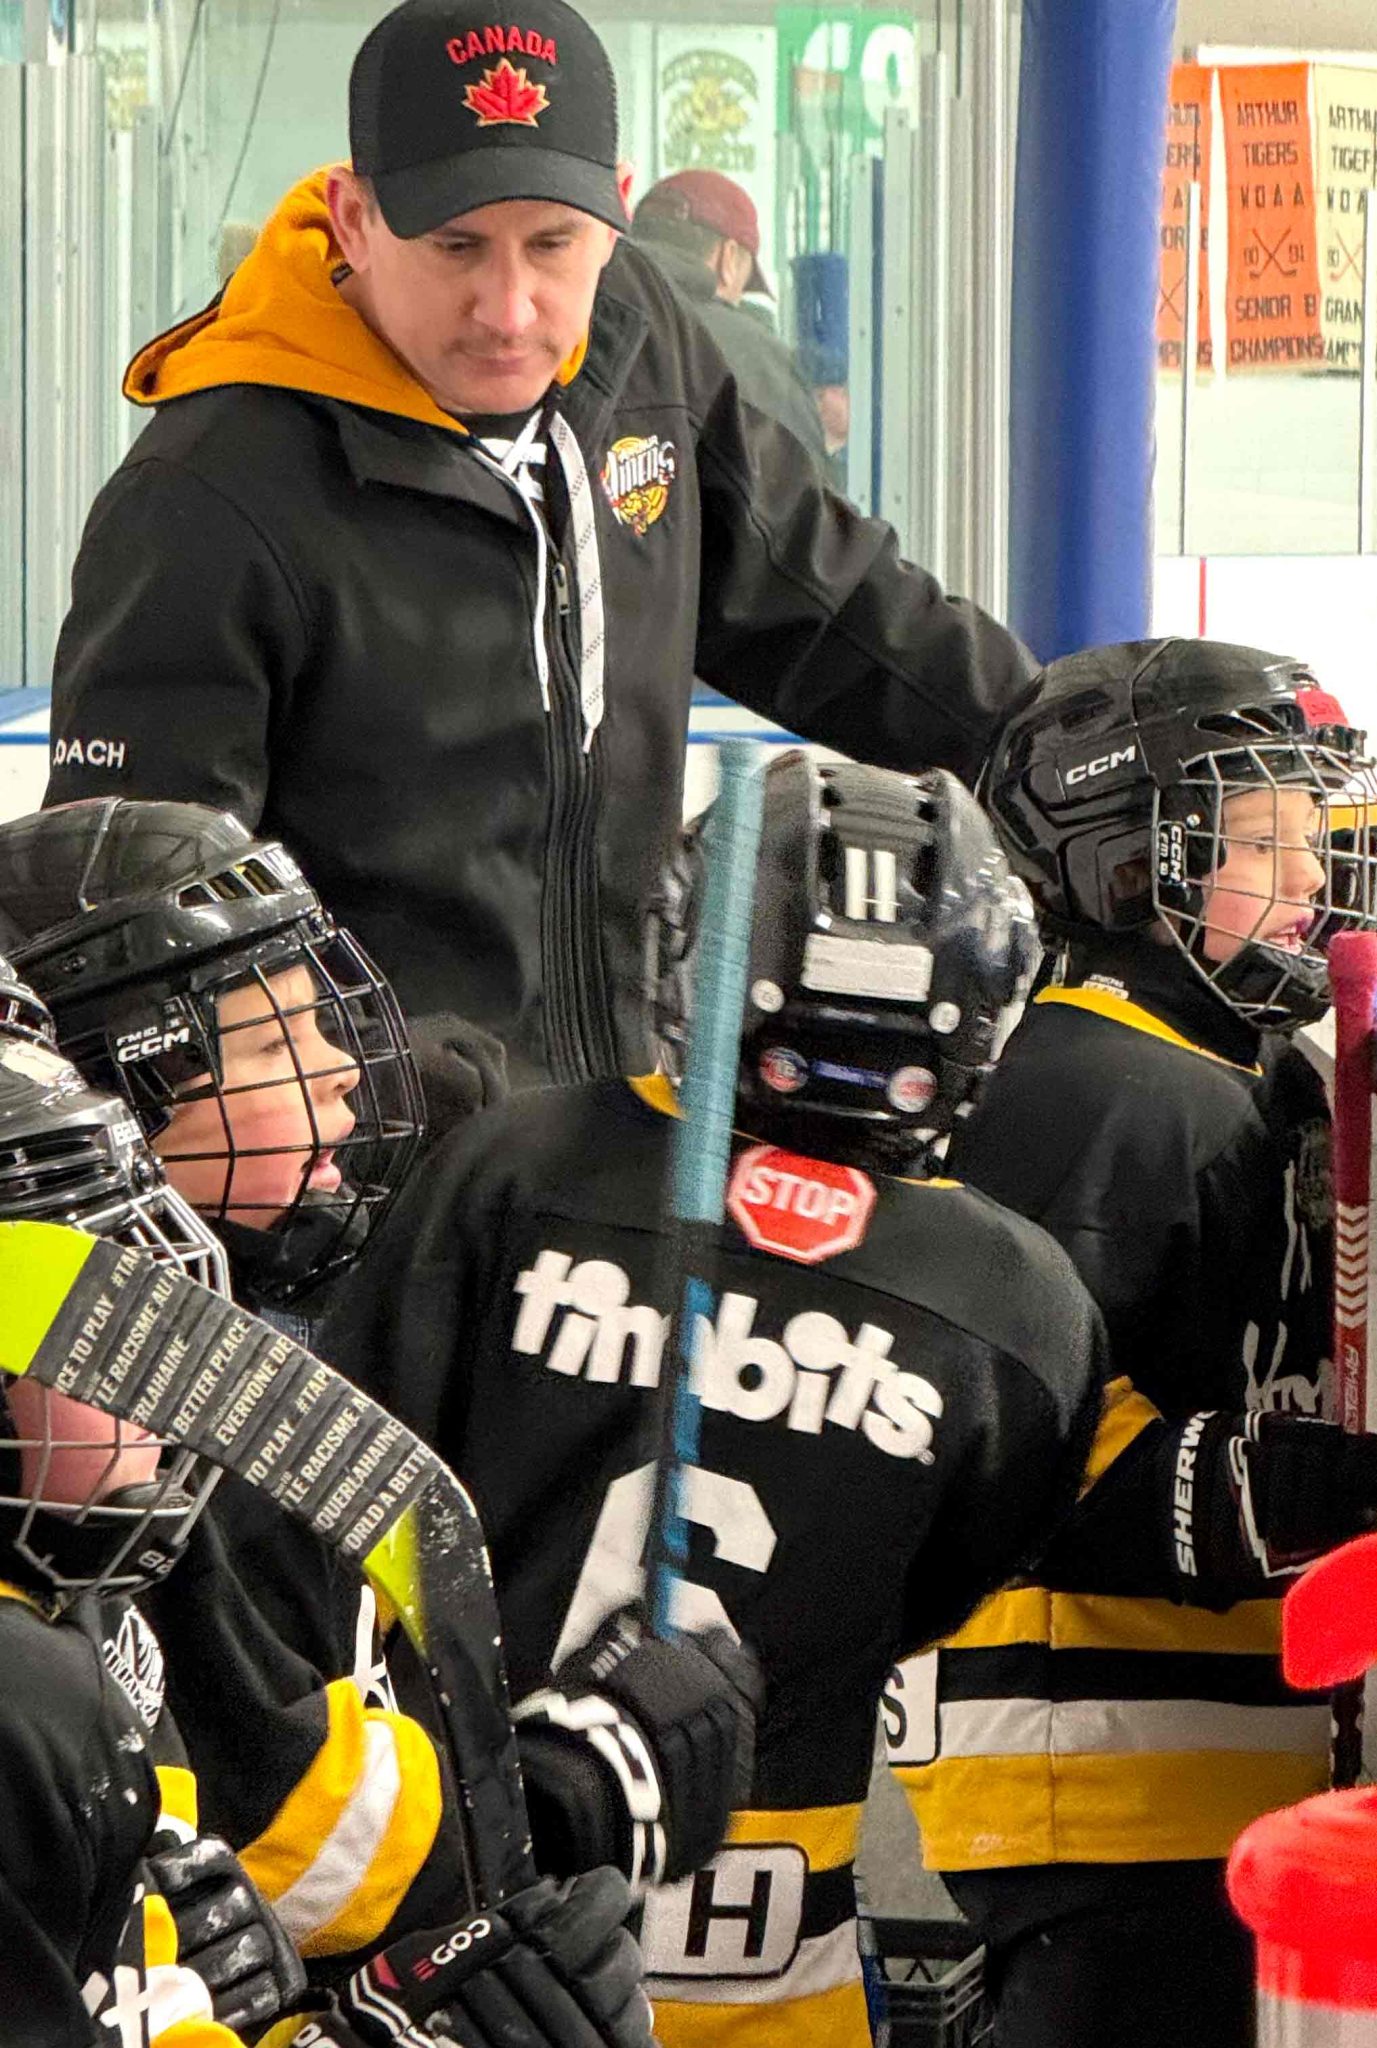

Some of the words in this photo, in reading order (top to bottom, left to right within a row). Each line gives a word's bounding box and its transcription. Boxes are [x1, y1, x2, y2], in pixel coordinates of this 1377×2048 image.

[446, 24, 558, 66] CANADA
[1237, 100, 1299, 127] ARTHUR
[1243, 139, 1299, 167] TIGERS
[1235, 293, 1292, 322] SENIOR
[52, 738, 126, 769] OACH
[1065, 745, 1136, 786] CCM
[1170, 825, 1183, 882] CCM
[117, 1027, 190, 1063] CCM
[740, 1166, 856, 1227] STOP
[68, 1337, 94, 1365] TO
[82, 1293, 115, 1342] PLAY
[108, 1302, 160, 1383] RACISME
[96, 1376, 121, 1405] LE
[172, 1368, 219, 1436] BETTER
[209, 1317, 251, 1374] PLACE
[214, 1358, 279, 1446] EVERYONE
[244, 1460, 269, 1487] TO
[259, 1417, 297, 1466] PLAY
[300, 1407, 361, 1484] RACISME
[684, 1869, 773, 1958] H
